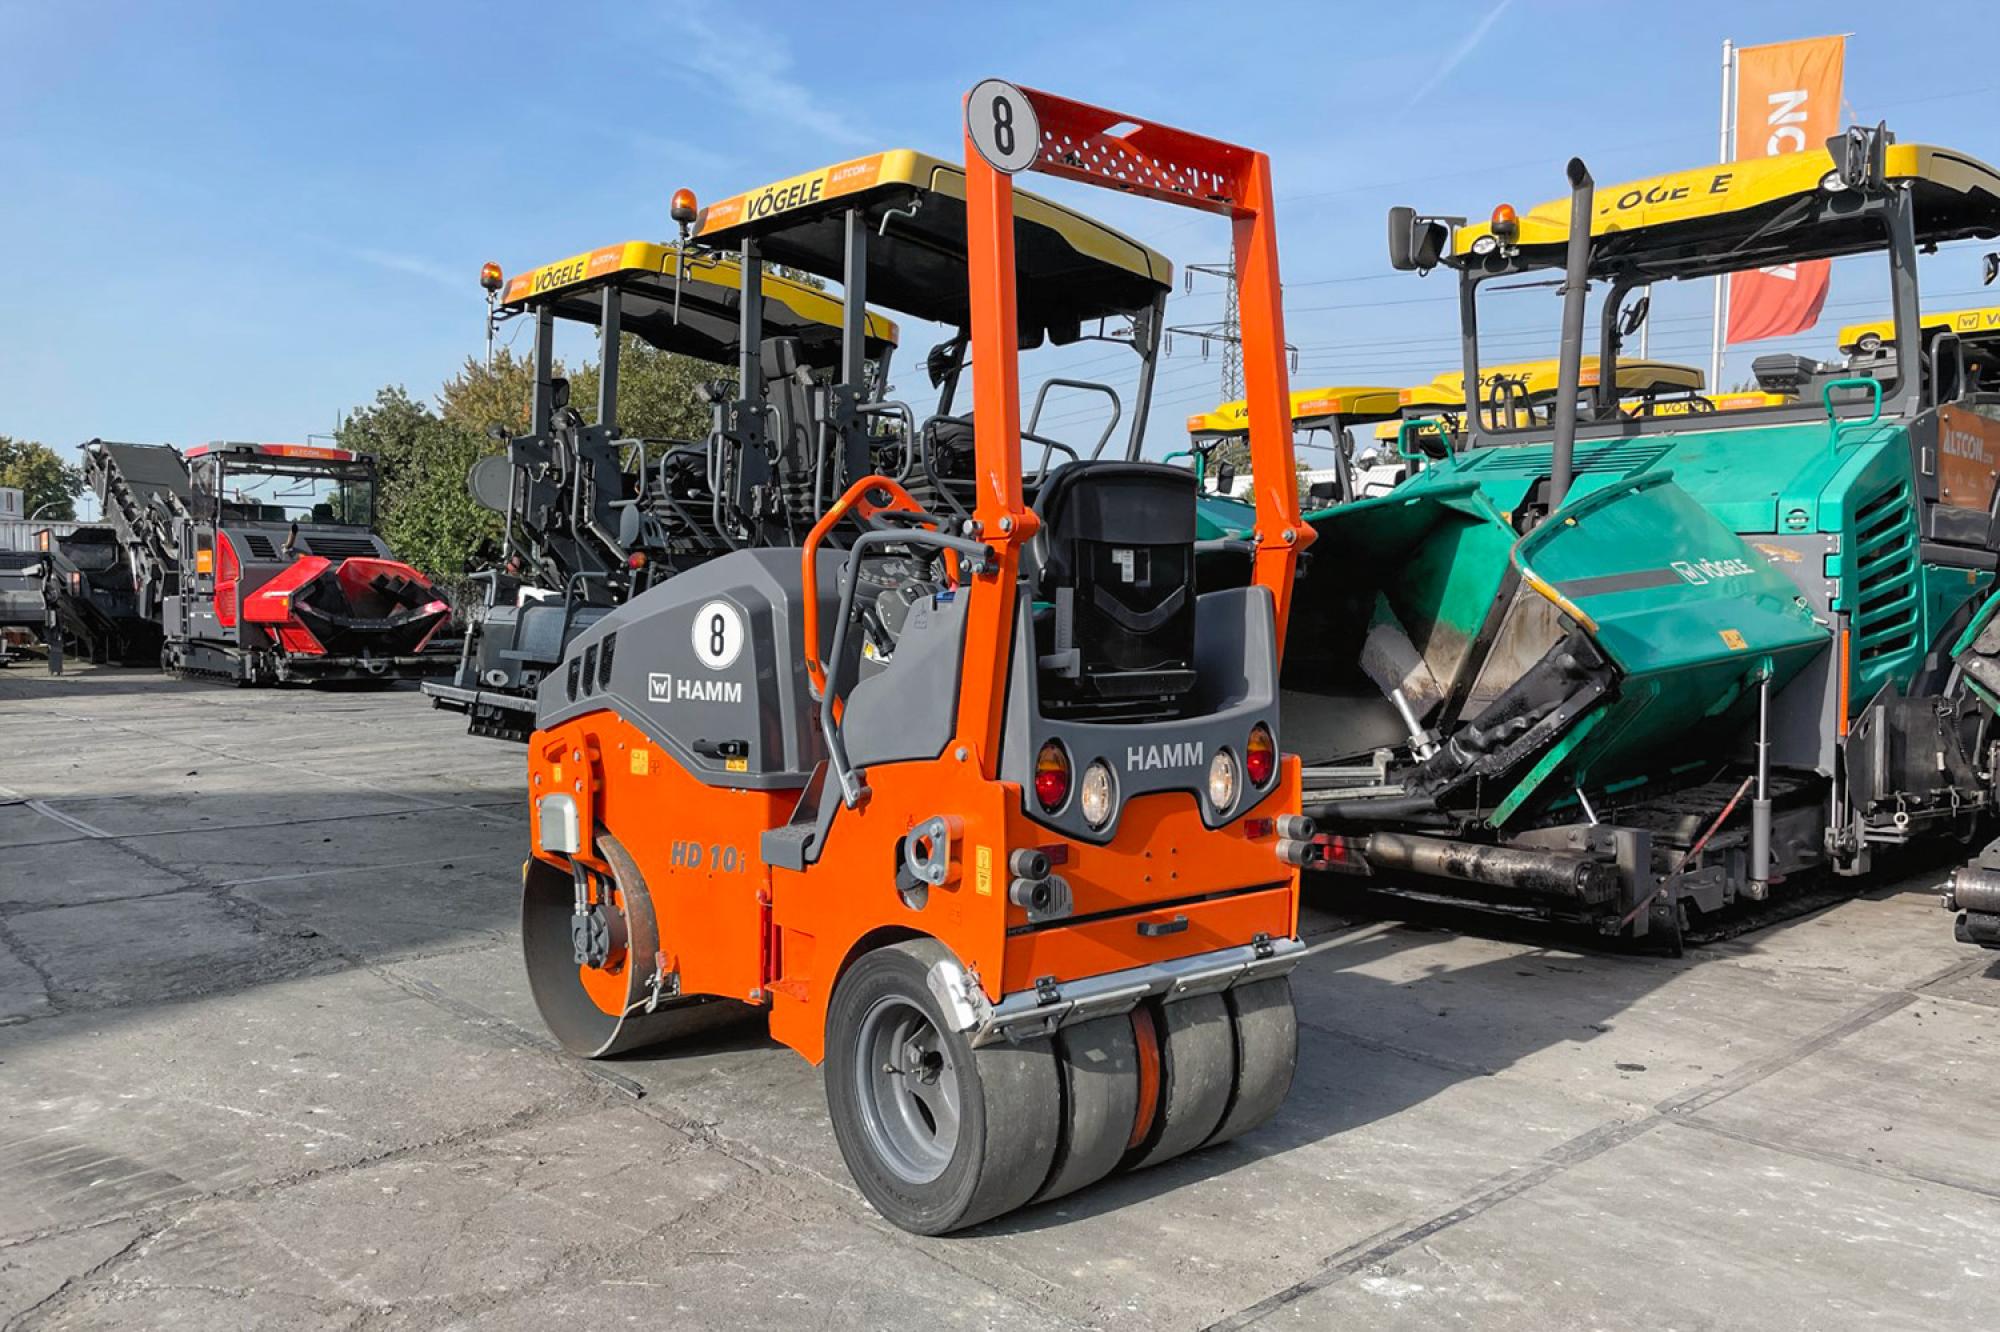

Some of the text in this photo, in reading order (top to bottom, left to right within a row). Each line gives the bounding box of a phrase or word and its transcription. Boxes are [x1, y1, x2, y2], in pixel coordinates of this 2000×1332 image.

[992, 95, 1015, 156] 8
[747, 178, 823, 220] VÖGELE
[535, 261, 585, 292] VÖGELE
[710, 613, 725, 657] 8
[676, 679, 742, 703] HAMM
[1127, 741, 1203, 772] HAMM
[671, 840, 702, 869] HD
